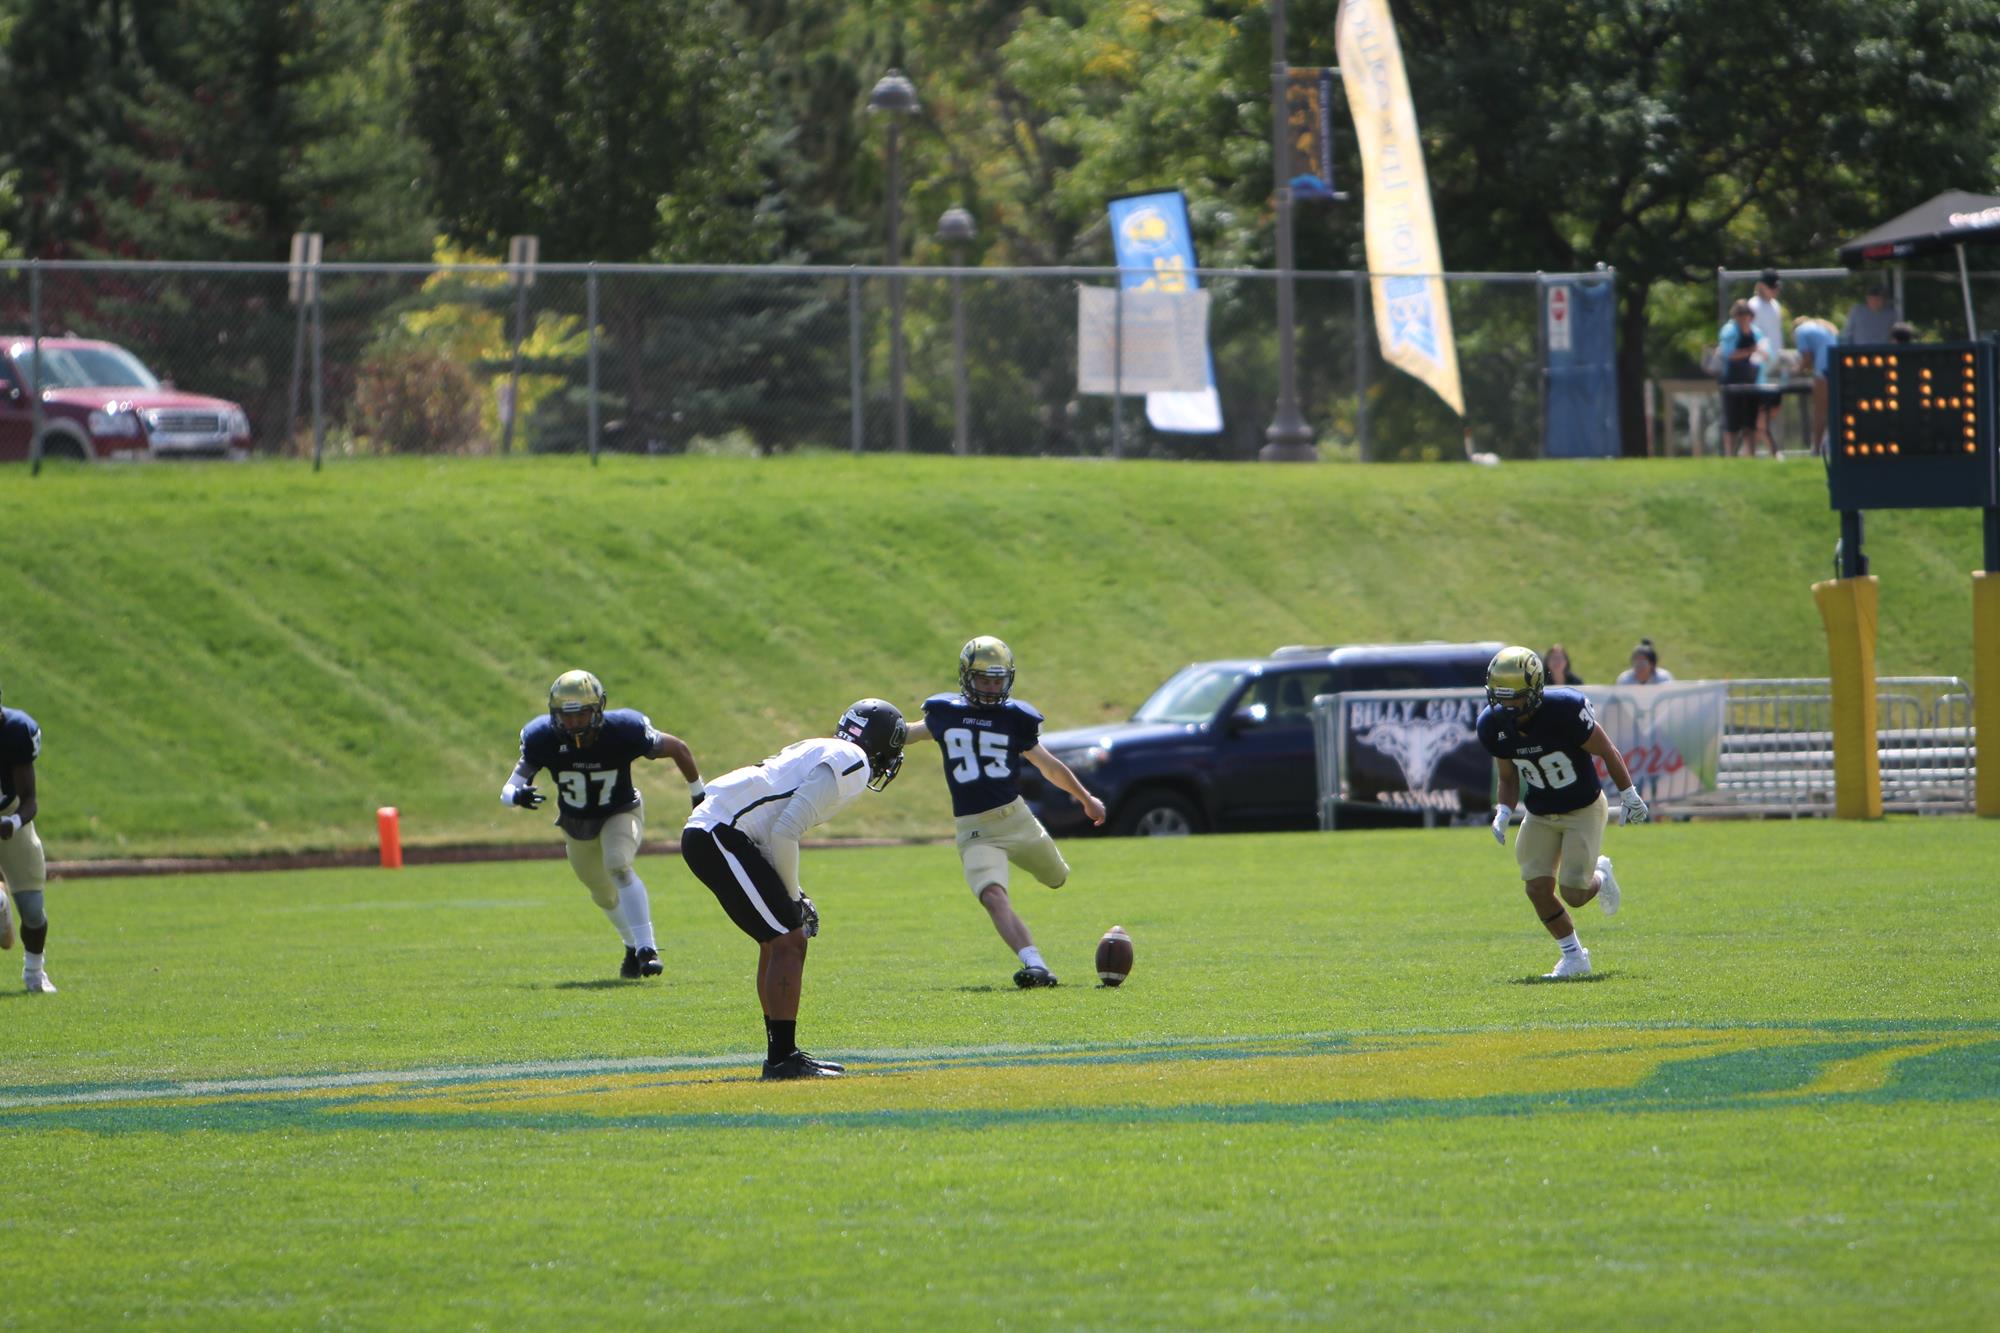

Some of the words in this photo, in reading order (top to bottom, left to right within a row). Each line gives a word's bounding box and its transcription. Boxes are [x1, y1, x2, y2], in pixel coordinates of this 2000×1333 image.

[1844, 353, 1976, 455] 24
[1351, 700, 1415, 730] BILLY
[944, 728, 1011, 783] 95
[558, 769, 618, 808] 37
